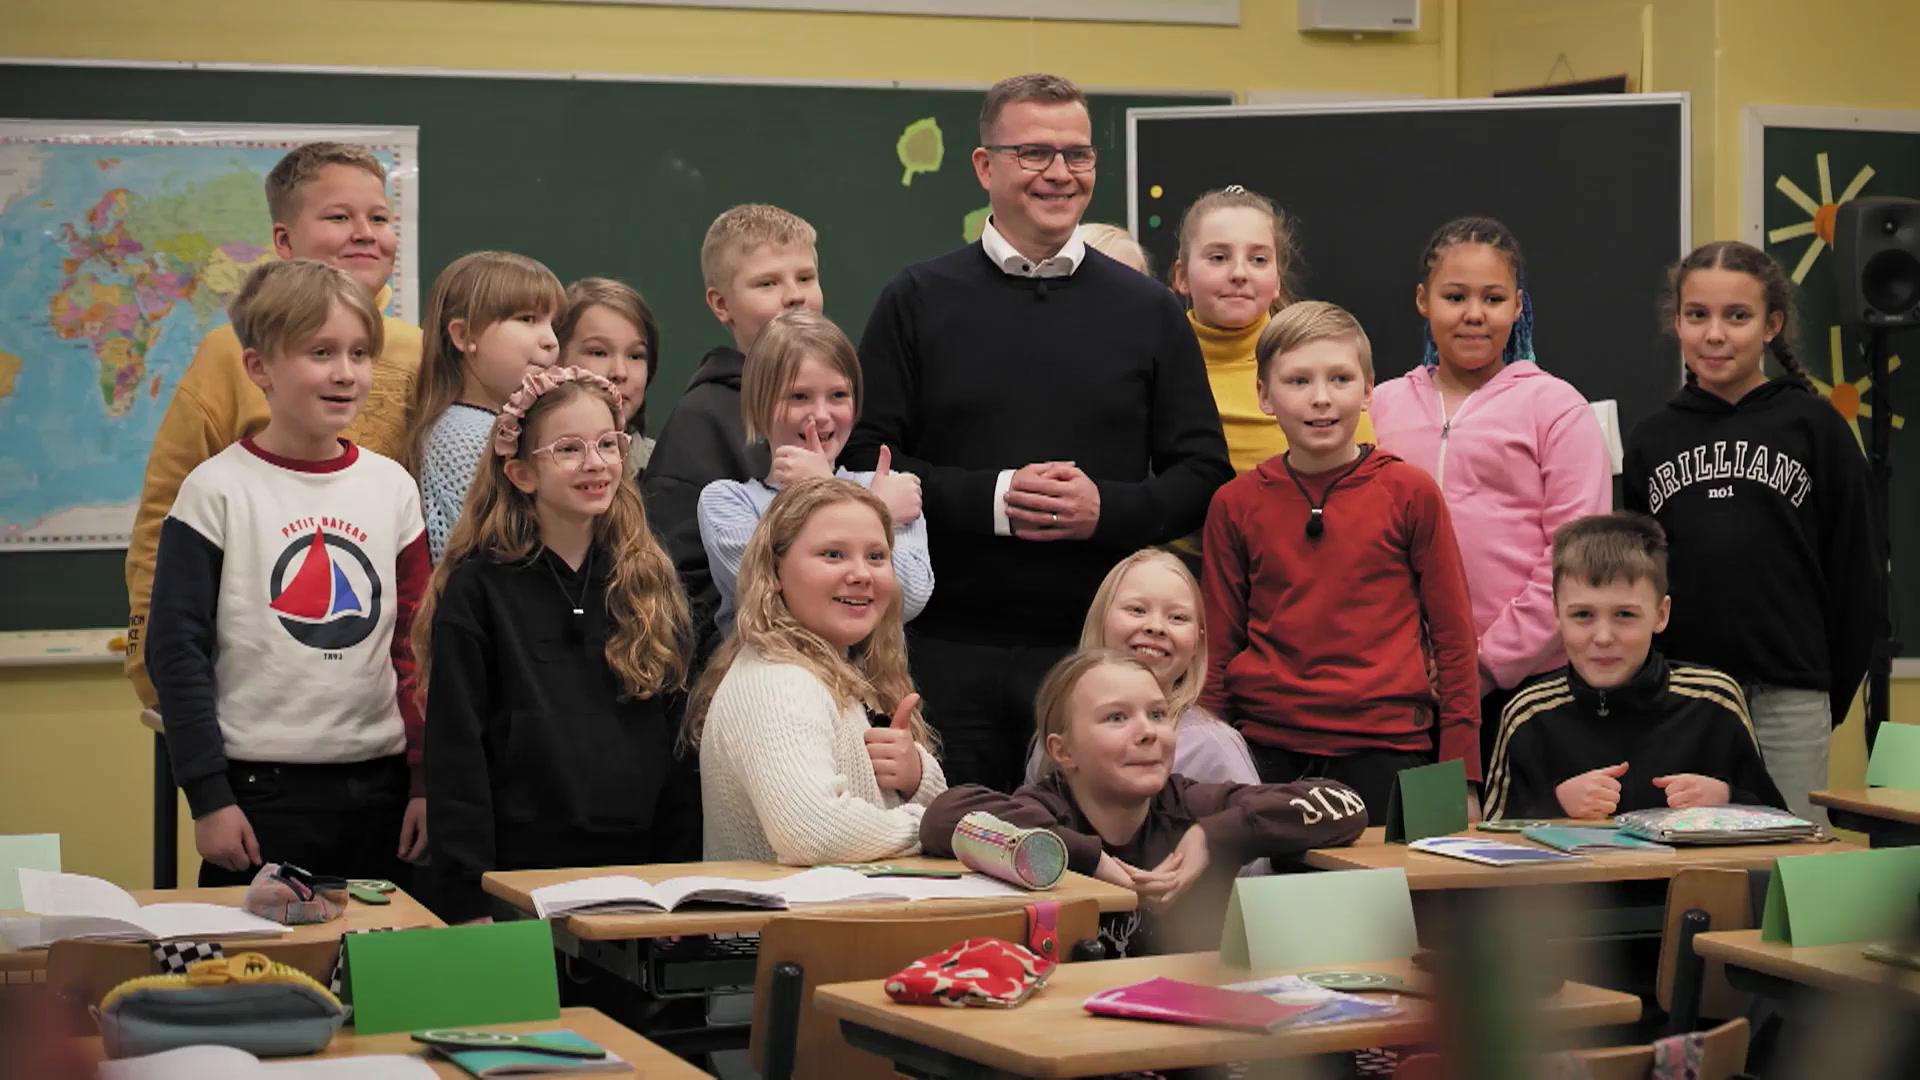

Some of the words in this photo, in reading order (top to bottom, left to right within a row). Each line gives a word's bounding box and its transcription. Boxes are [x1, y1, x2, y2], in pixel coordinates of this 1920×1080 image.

[1648, 440, 1813, 515] BRILLIANT
[1708, 485, 1735, 499] no1
[281, 516, 315, 538] PETIT
[321, 516, 368, 543] BATEAU
